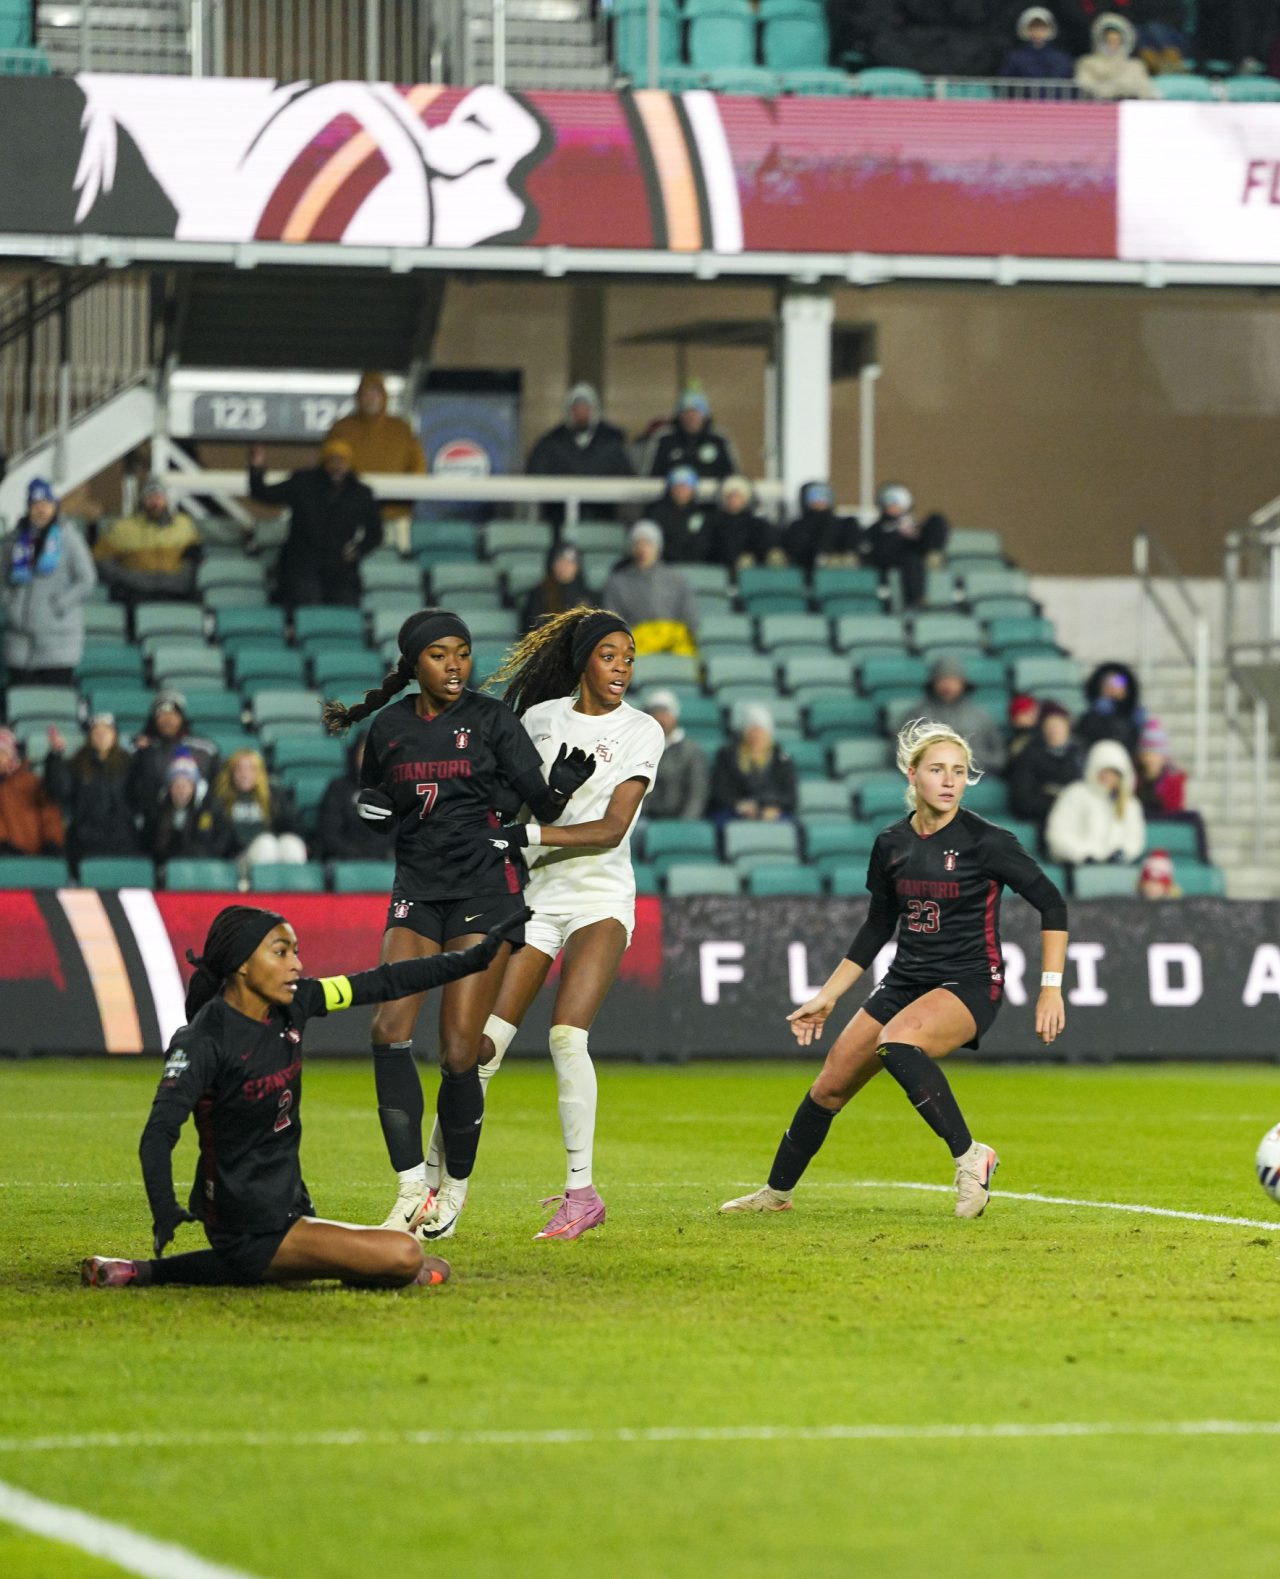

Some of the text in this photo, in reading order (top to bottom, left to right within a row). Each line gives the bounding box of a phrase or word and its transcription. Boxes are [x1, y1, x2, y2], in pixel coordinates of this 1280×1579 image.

[210, 398, 268, 430] 123
[416, 783, 438, 819] 7
[907, 899, 940, 934] 23
[273, 1089, 292, 1133] 2
